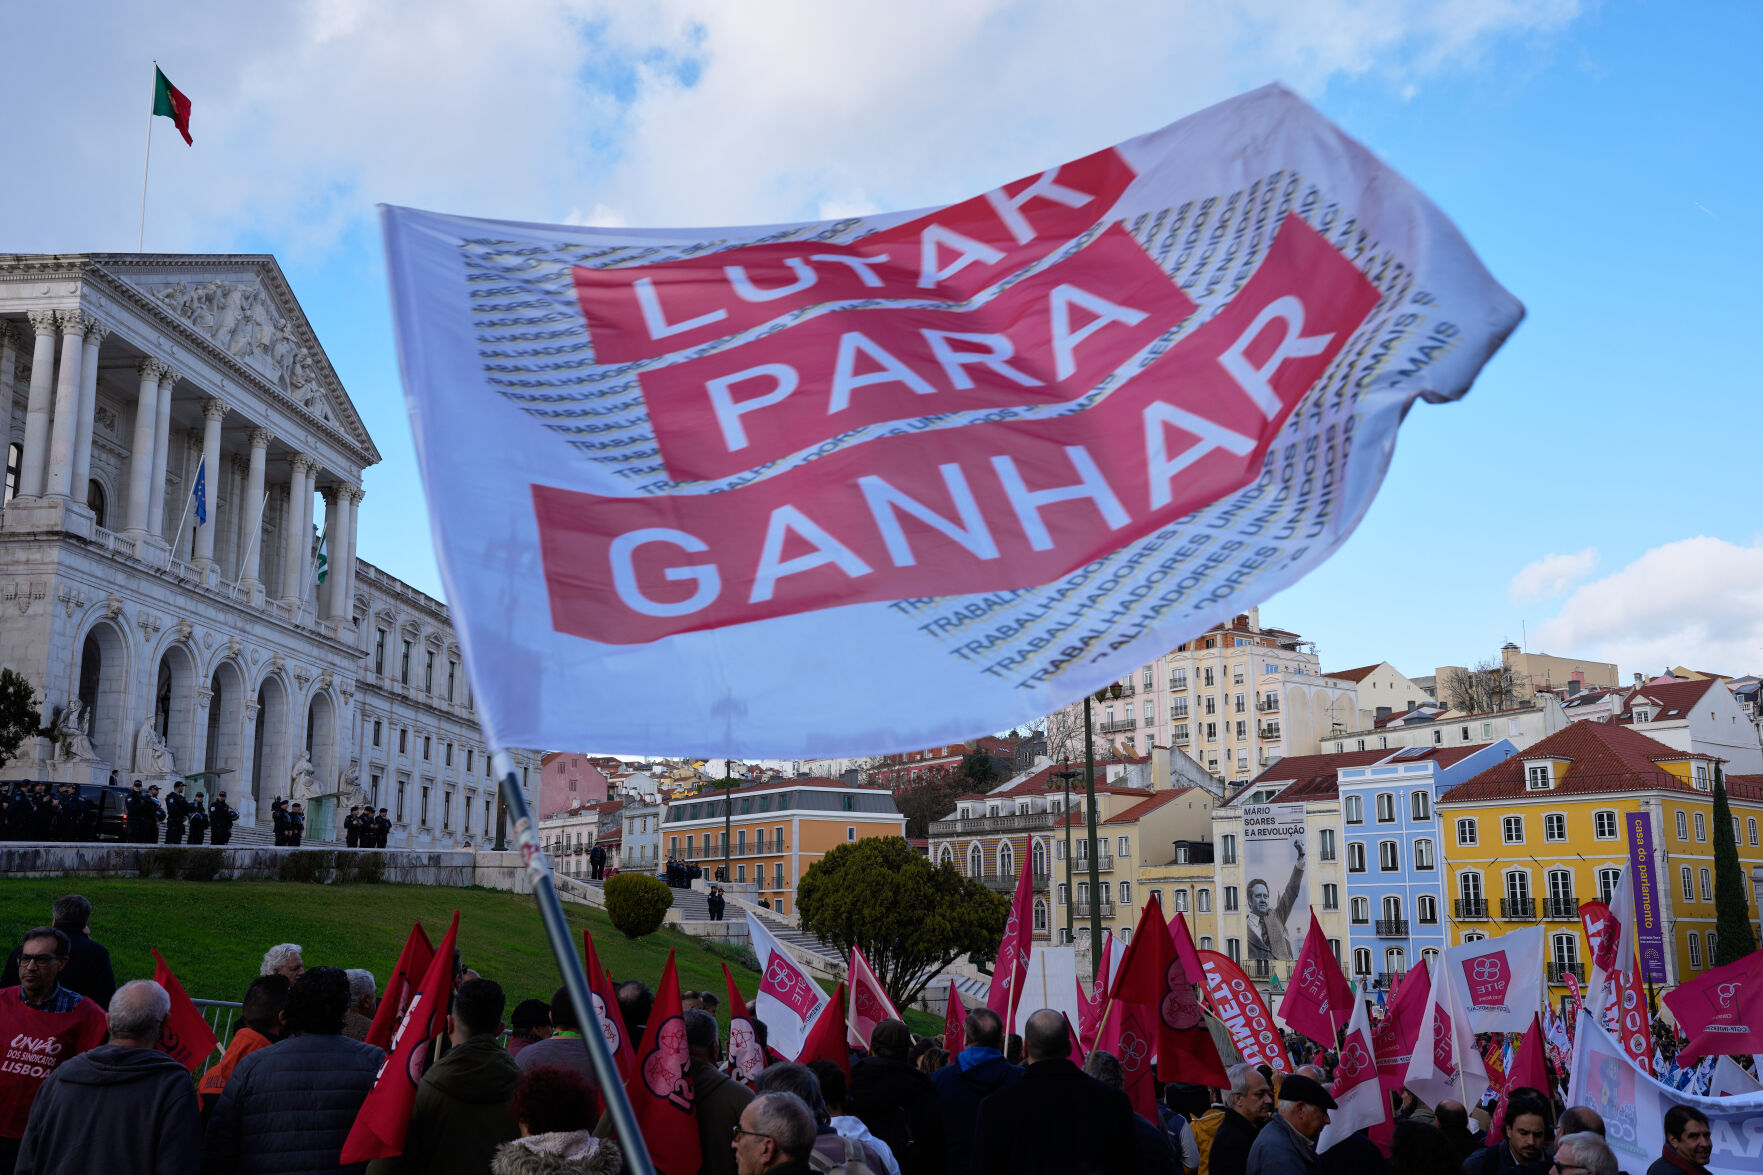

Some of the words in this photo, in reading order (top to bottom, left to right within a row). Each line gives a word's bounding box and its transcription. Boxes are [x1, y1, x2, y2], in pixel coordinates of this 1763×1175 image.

[632, 166, 1096, 341] LUTAR
[705, 283, 1150, 452] PARA
[608, 295, 1337, 618] GANHAR
[1207, 450, 1276, 528] UNIDOS
[1238, 443, 1298, 536] UNIDOS
[980, 529, 1177, 678] TRABALHADORES
[1244, 805, 1271, 816] MÁRIO
[1244, 817, 1276, 826] SOARES
[1245, 829, 1250, 837] E
[1251, 829, 1257, 837] A
[1258, 825, 1305, 838] REVOLUÇÃO
[1635, 819, 1645, 845] casa
[1637, 847, 1648, 863] do
[1637, 864, 1653, 929] parlamento
[10, 1033, 63, 1055] UNIÃO
[0, 1060, 51, 1079] LISBOA
[6, 1049, 21, 1060] DOS
[21, 1051, 57, 1067] SINDICATOS
